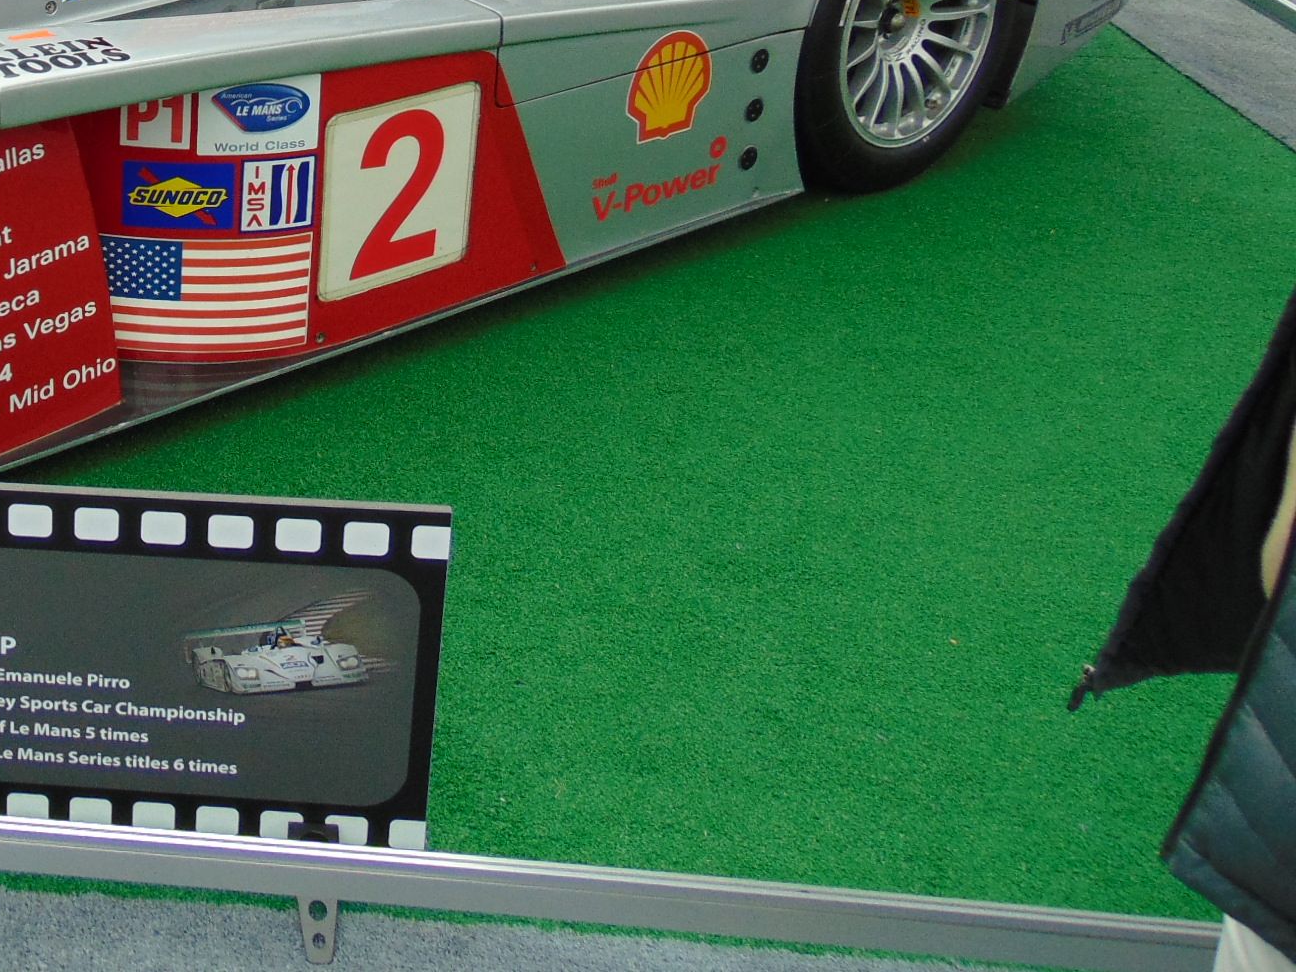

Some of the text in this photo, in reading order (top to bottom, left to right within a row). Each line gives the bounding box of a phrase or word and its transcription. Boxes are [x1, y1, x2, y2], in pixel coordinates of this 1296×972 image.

[127, 93, 184, 143] P1
[236, 104, 282, 117] LE MANS
[214, 139, 306, 153] World Class
[132, 190, 220, 206] SUNOCO
[247, 165, 266, 227] IMSA
[349, 108, 445, 281] 2
[592, 164, 721, 222] V-Power
[4, 233, 90, 280] Jarama
[23, 300, 97, 341] Vegas
[9, 379, 55, 414] Mid
[62, 356, 116, 391] Ohio
[87, 674, 131, 689] Pirro
[20, 696, 78, 713] Sports
[81, 700, 111, 714] Car
[115, 701, 246, 726] Championship
[9, 721, 29, 735] Le
[34, 723, 81, 738] Mans
[85, 726, 95, 739] 5
[100, 727, 149, 743] times
[17, 747, 65, 763] Mans
[68, 750, 121, 767] Series
[125, 754, 169, 770] titles
[173, 758, 184, 771] 6
[188, 759, 238, 775] times
